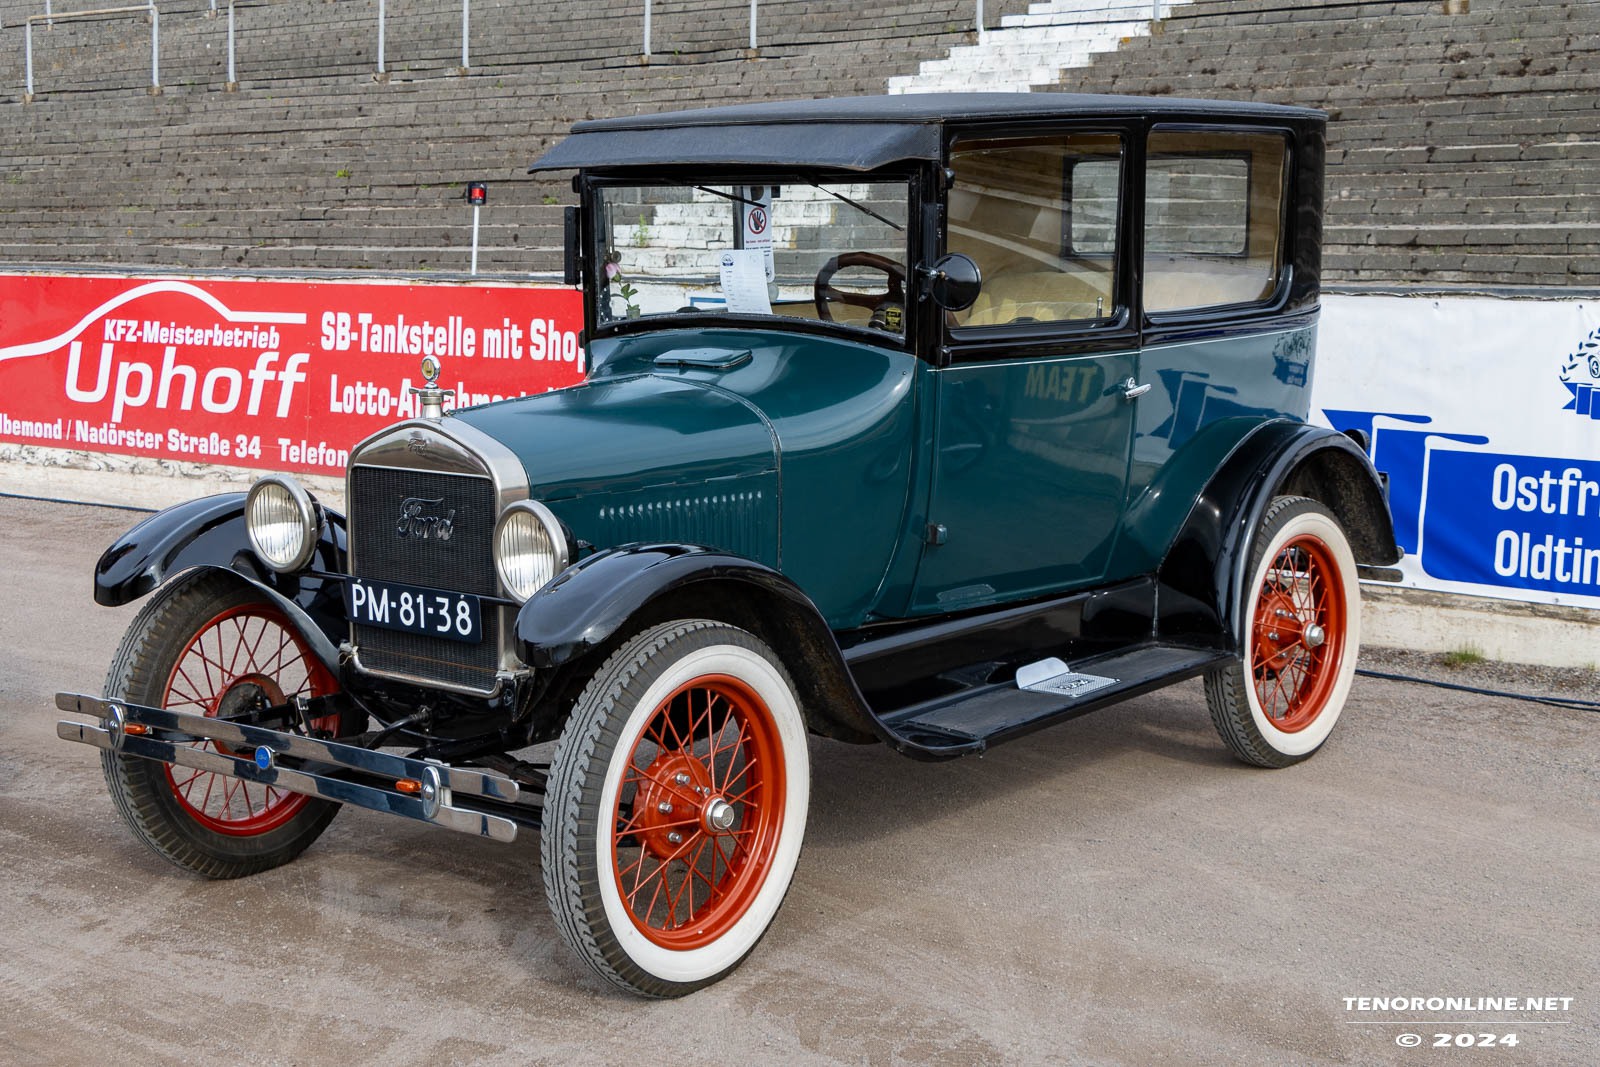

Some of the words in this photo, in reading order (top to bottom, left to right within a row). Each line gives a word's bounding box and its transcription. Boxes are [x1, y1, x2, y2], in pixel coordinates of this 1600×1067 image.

[104, 319, 280, 349] KFZ-Meisterbetrieb
[321, 311, 476, 357] SB-Tankstelle
[483, 318, 523, 359] mit
[65, 340, 310, 423] Uphoff
[75, 419, 163, 450] Nadörster
[167, 428, 230, 457] Straße
[235, 434, 261, 460] 34
[278, 437, 349, 467] Telefon
[1492, 463, 1600, 517] Ostfr
[396, 498, 455, 540] Ford
[352, 584, 472, 635] PM-81-38
